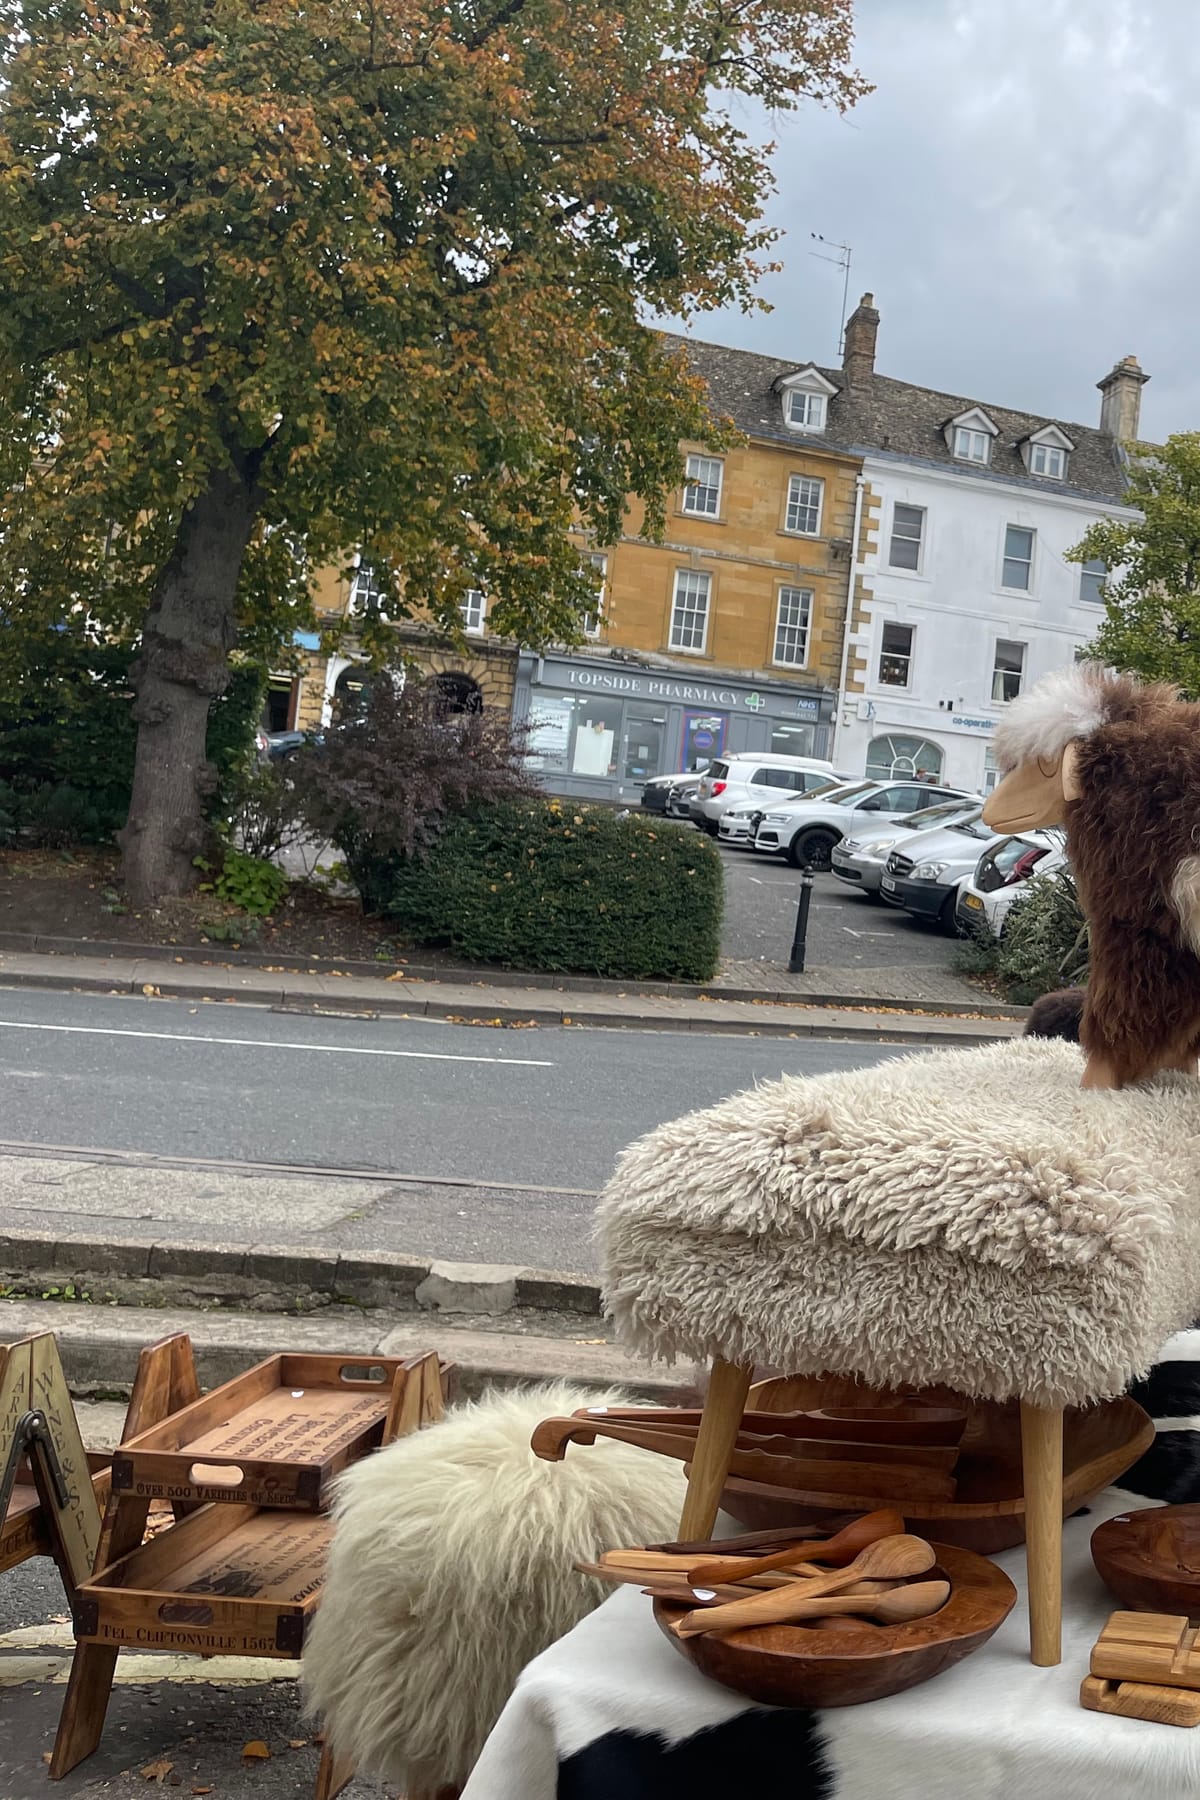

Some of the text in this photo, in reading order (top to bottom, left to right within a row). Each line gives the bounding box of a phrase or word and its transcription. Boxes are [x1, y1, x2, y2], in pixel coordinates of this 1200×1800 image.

[567, 669, 741, 706] TOPSIDE PHARMACY
[797, 700, 817, 710] NHS
[36, 1364, 66, 1453] WINE
[62, 1457, 76, 1481] &
[136, 1482, 164, 1496] OVER
[167, 1486, 191, 1498] 500
[196, 1486, 247, 1501] VARIETIES
[102, 1624, 276, 1651] TEL. CLIFTONVILLE 1567
